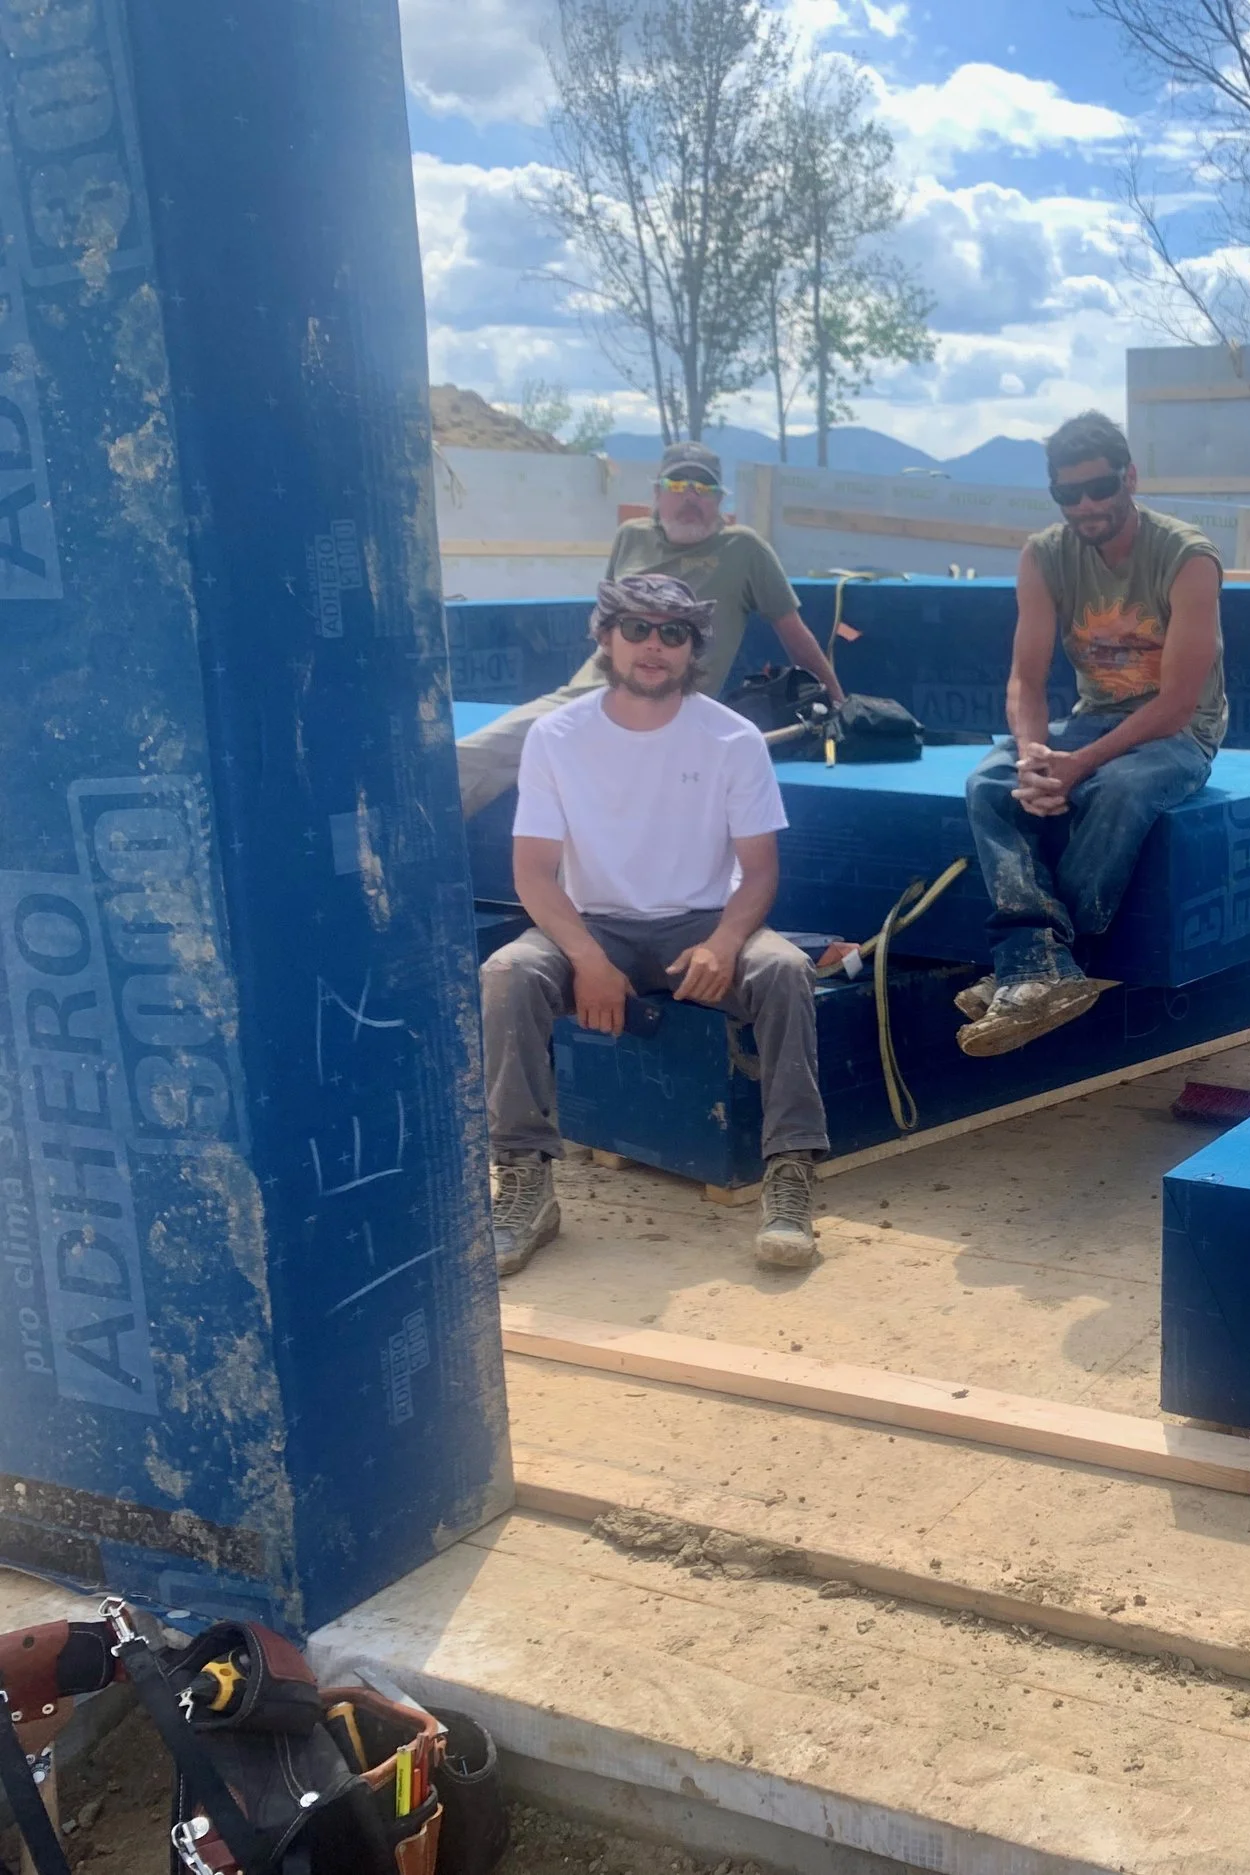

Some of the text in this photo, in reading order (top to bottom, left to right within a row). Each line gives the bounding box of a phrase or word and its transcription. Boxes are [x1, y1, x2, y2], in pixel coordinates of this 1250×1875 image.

[318, 537, 340, 633] ADHERO
[94, 808, 230, 1129] 3000
[13, 893, 142, 1393] ADHERO
[0, 1177, 37, 1290] clima
[17, 1306, 53, 1376] pro
[391, 1334, 411, 1417] ADHERO
